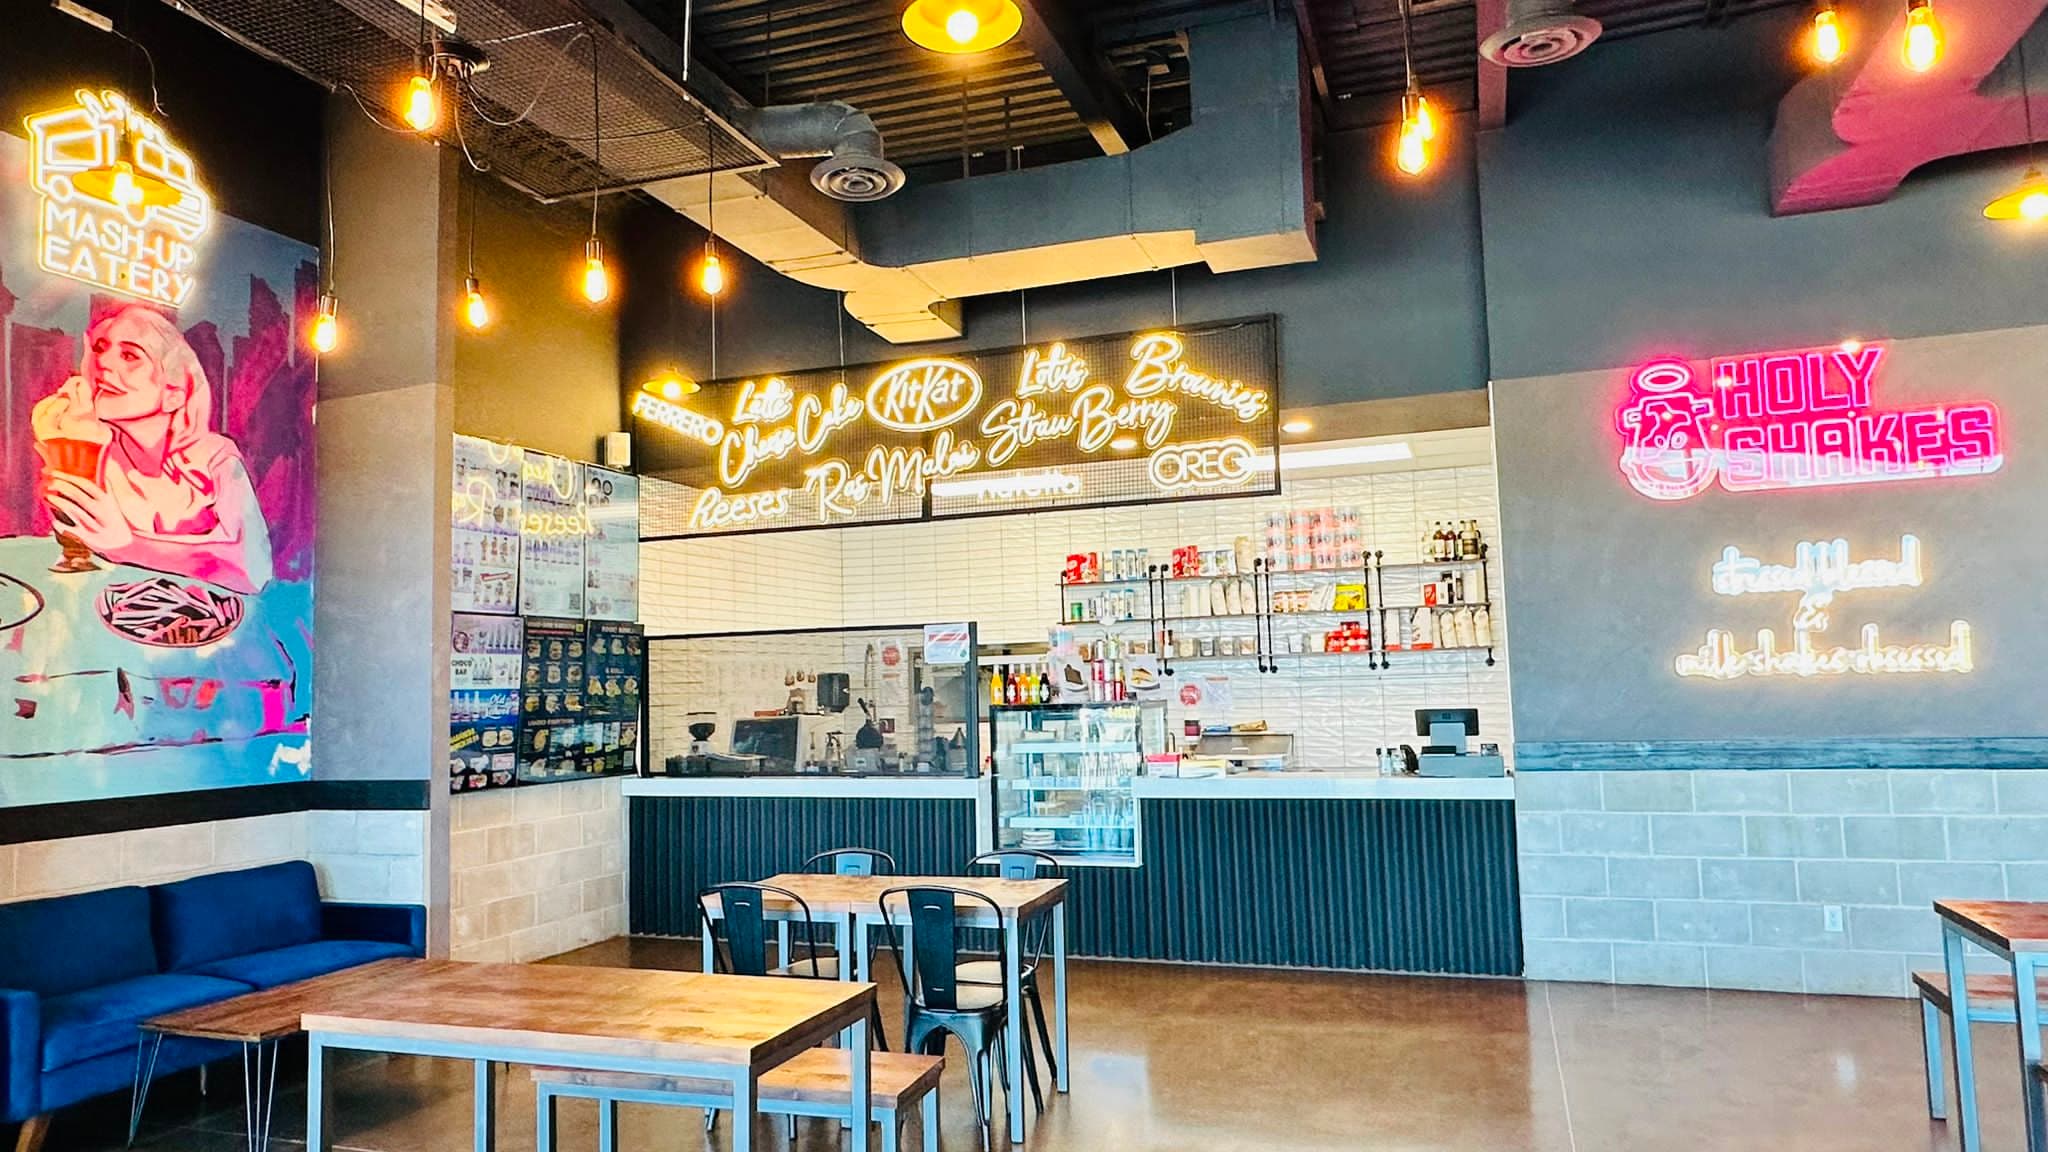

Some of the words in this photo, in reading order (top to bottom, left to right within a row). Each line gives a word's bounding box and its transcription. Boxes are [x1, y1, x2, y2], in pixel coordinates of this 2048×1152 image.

[46, 199, 194, 273] MASH-UP
[46, 235, 194, 304] EATERY
[884, 367, 966, 424] KitKat
[1018, 343, 1087, 394] Lotus
[1127, 336, 1266, 418] Brownies
[1718, 347, 1883, 420] HOLY
[632, 391, 724, 446] FERRERO
[798, 384, 863, 452] Cake
[1723, 406, 1994, 484] SHAKES
